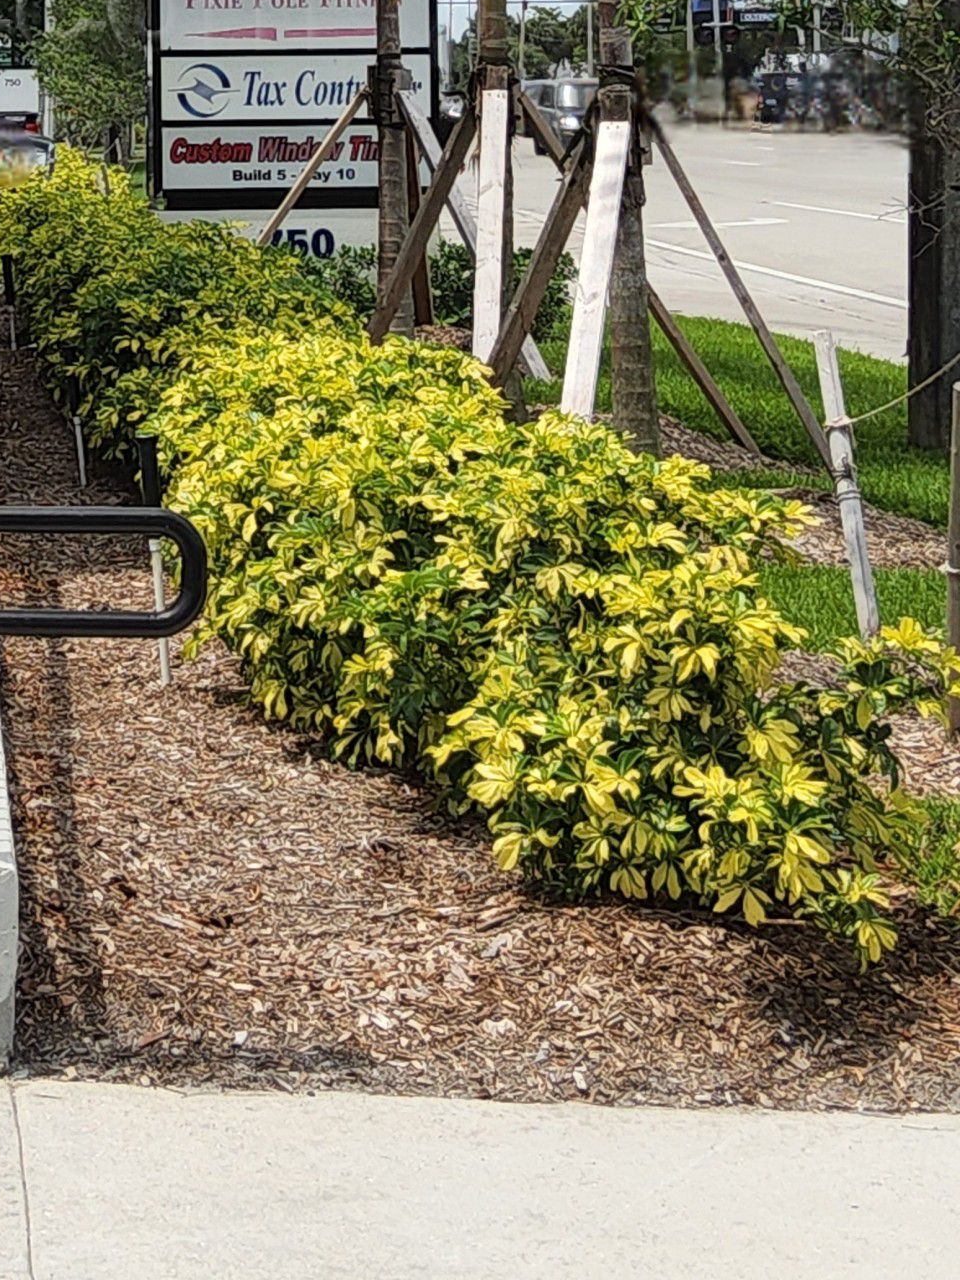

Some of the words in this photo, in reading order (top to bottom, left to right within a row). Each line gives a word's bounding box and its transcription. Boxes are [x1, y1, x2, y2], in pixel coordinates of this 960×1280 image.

[242, 70, 288, 107] Tax
[169, 136, 253, 164] Custom
[232, 169, 272, 181] Build
[277, 168, 287, 180] 5
[300, 168, 332, 183] ay
[336, 168, 356, 180] 10
